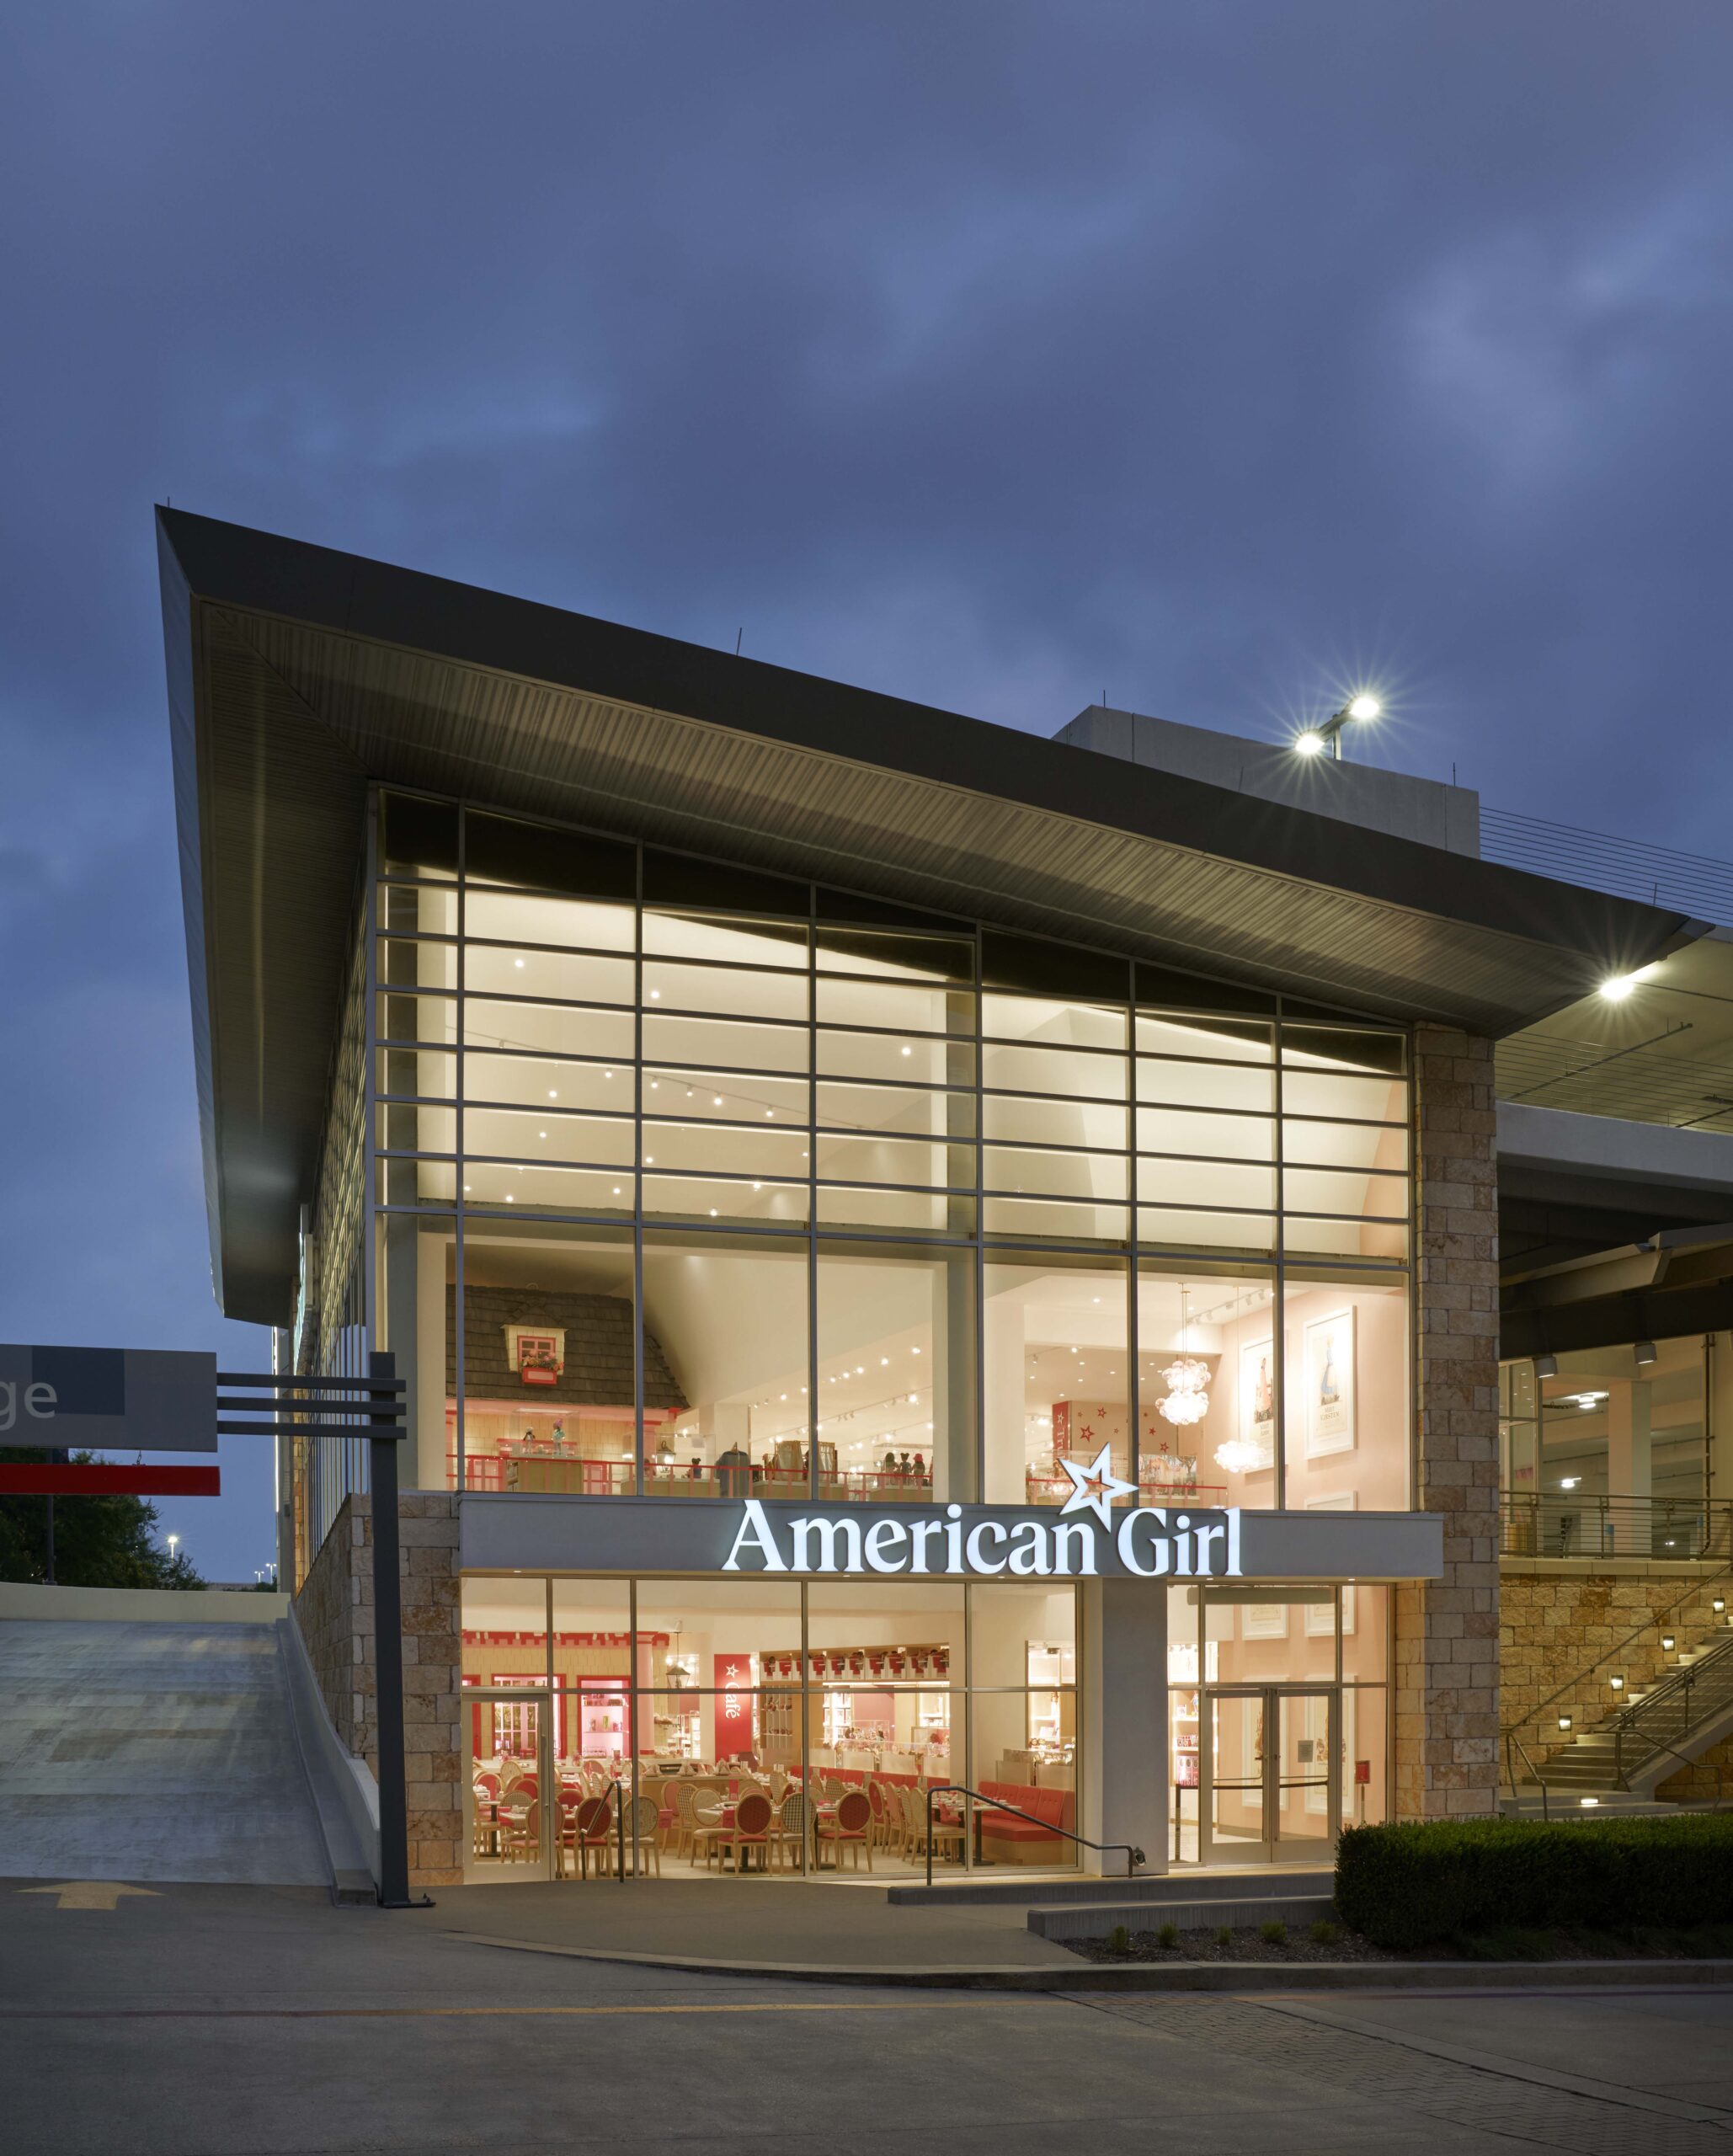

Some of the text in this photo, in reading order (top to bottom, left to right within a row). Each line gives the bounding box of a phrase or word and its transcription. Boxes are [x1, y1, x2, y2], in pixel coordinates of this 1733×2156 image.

[721, 1499, 1243, 1577] American Girl
[725, 1682, 741, 1719] Café
